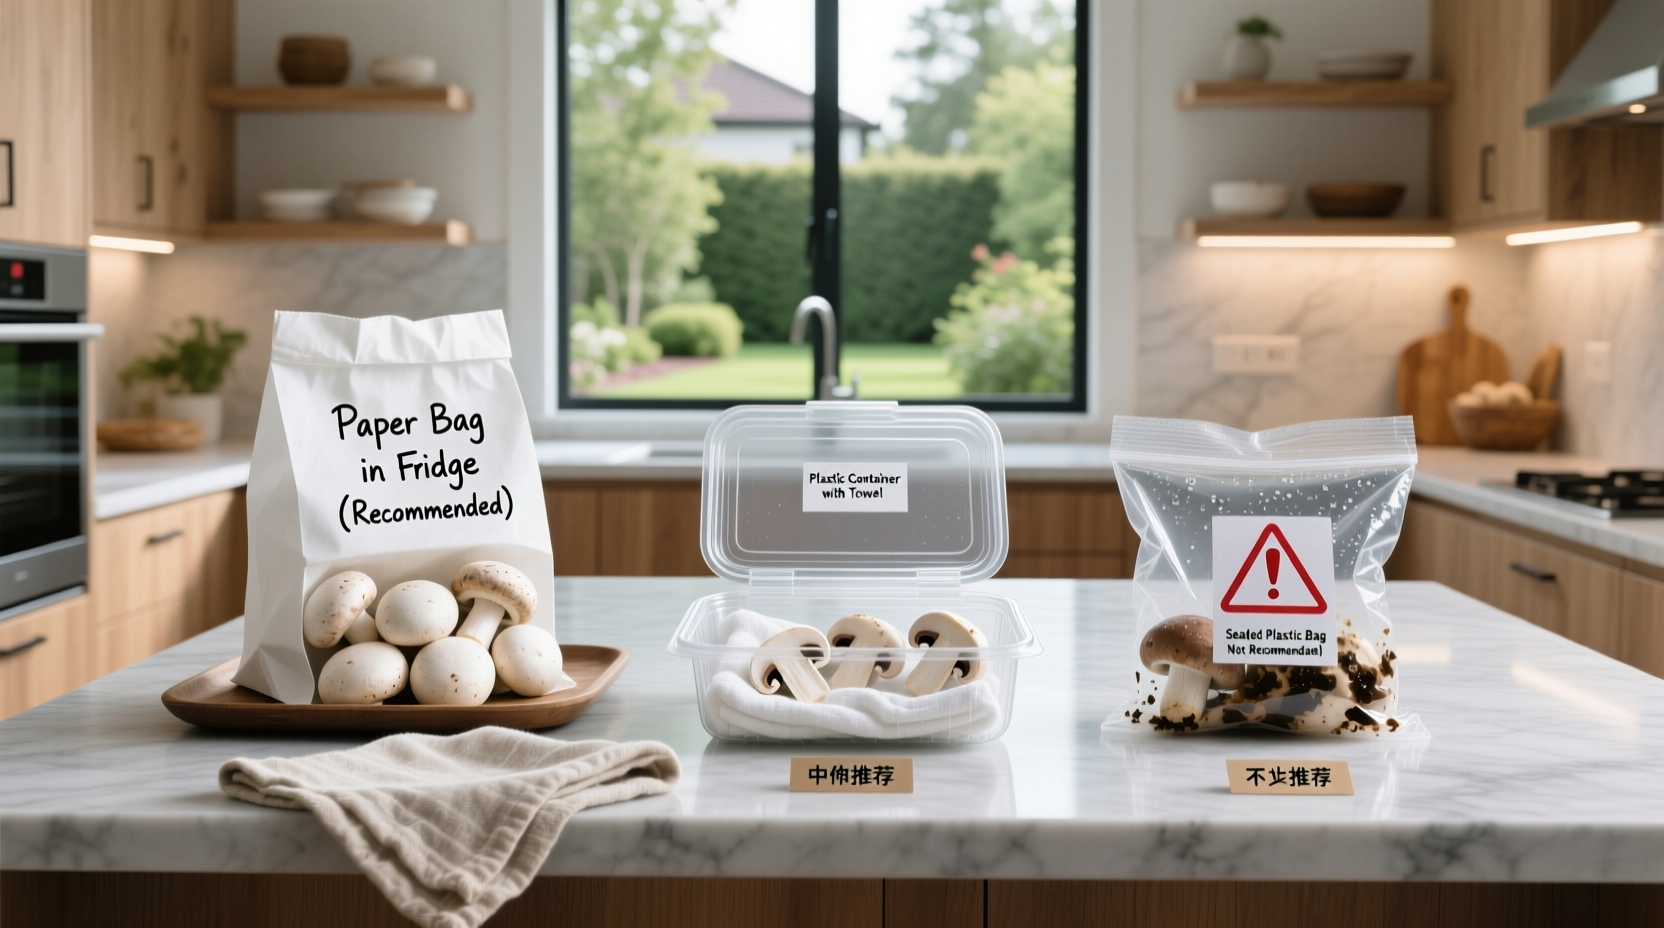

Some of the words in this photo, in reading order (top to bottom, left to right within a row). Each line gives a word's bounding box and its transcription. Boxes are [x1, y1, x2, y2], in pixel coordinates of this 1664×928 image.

[331, 403, 418, 450] Paper
[429, 402, 485, 444] Bag
[361, 458, 386, 482] in
[396, 448, 480, 490] Fridge
[821, 487, 846, 499] with
[848, 487, 883, 499] Towel
[339, 484, 514, 533] (Recommended)
[1227, 643, 1246, 655] Not
[1265, 628, 1303, 641] Plastic
[1304, 629, 1327, 644] Bag
